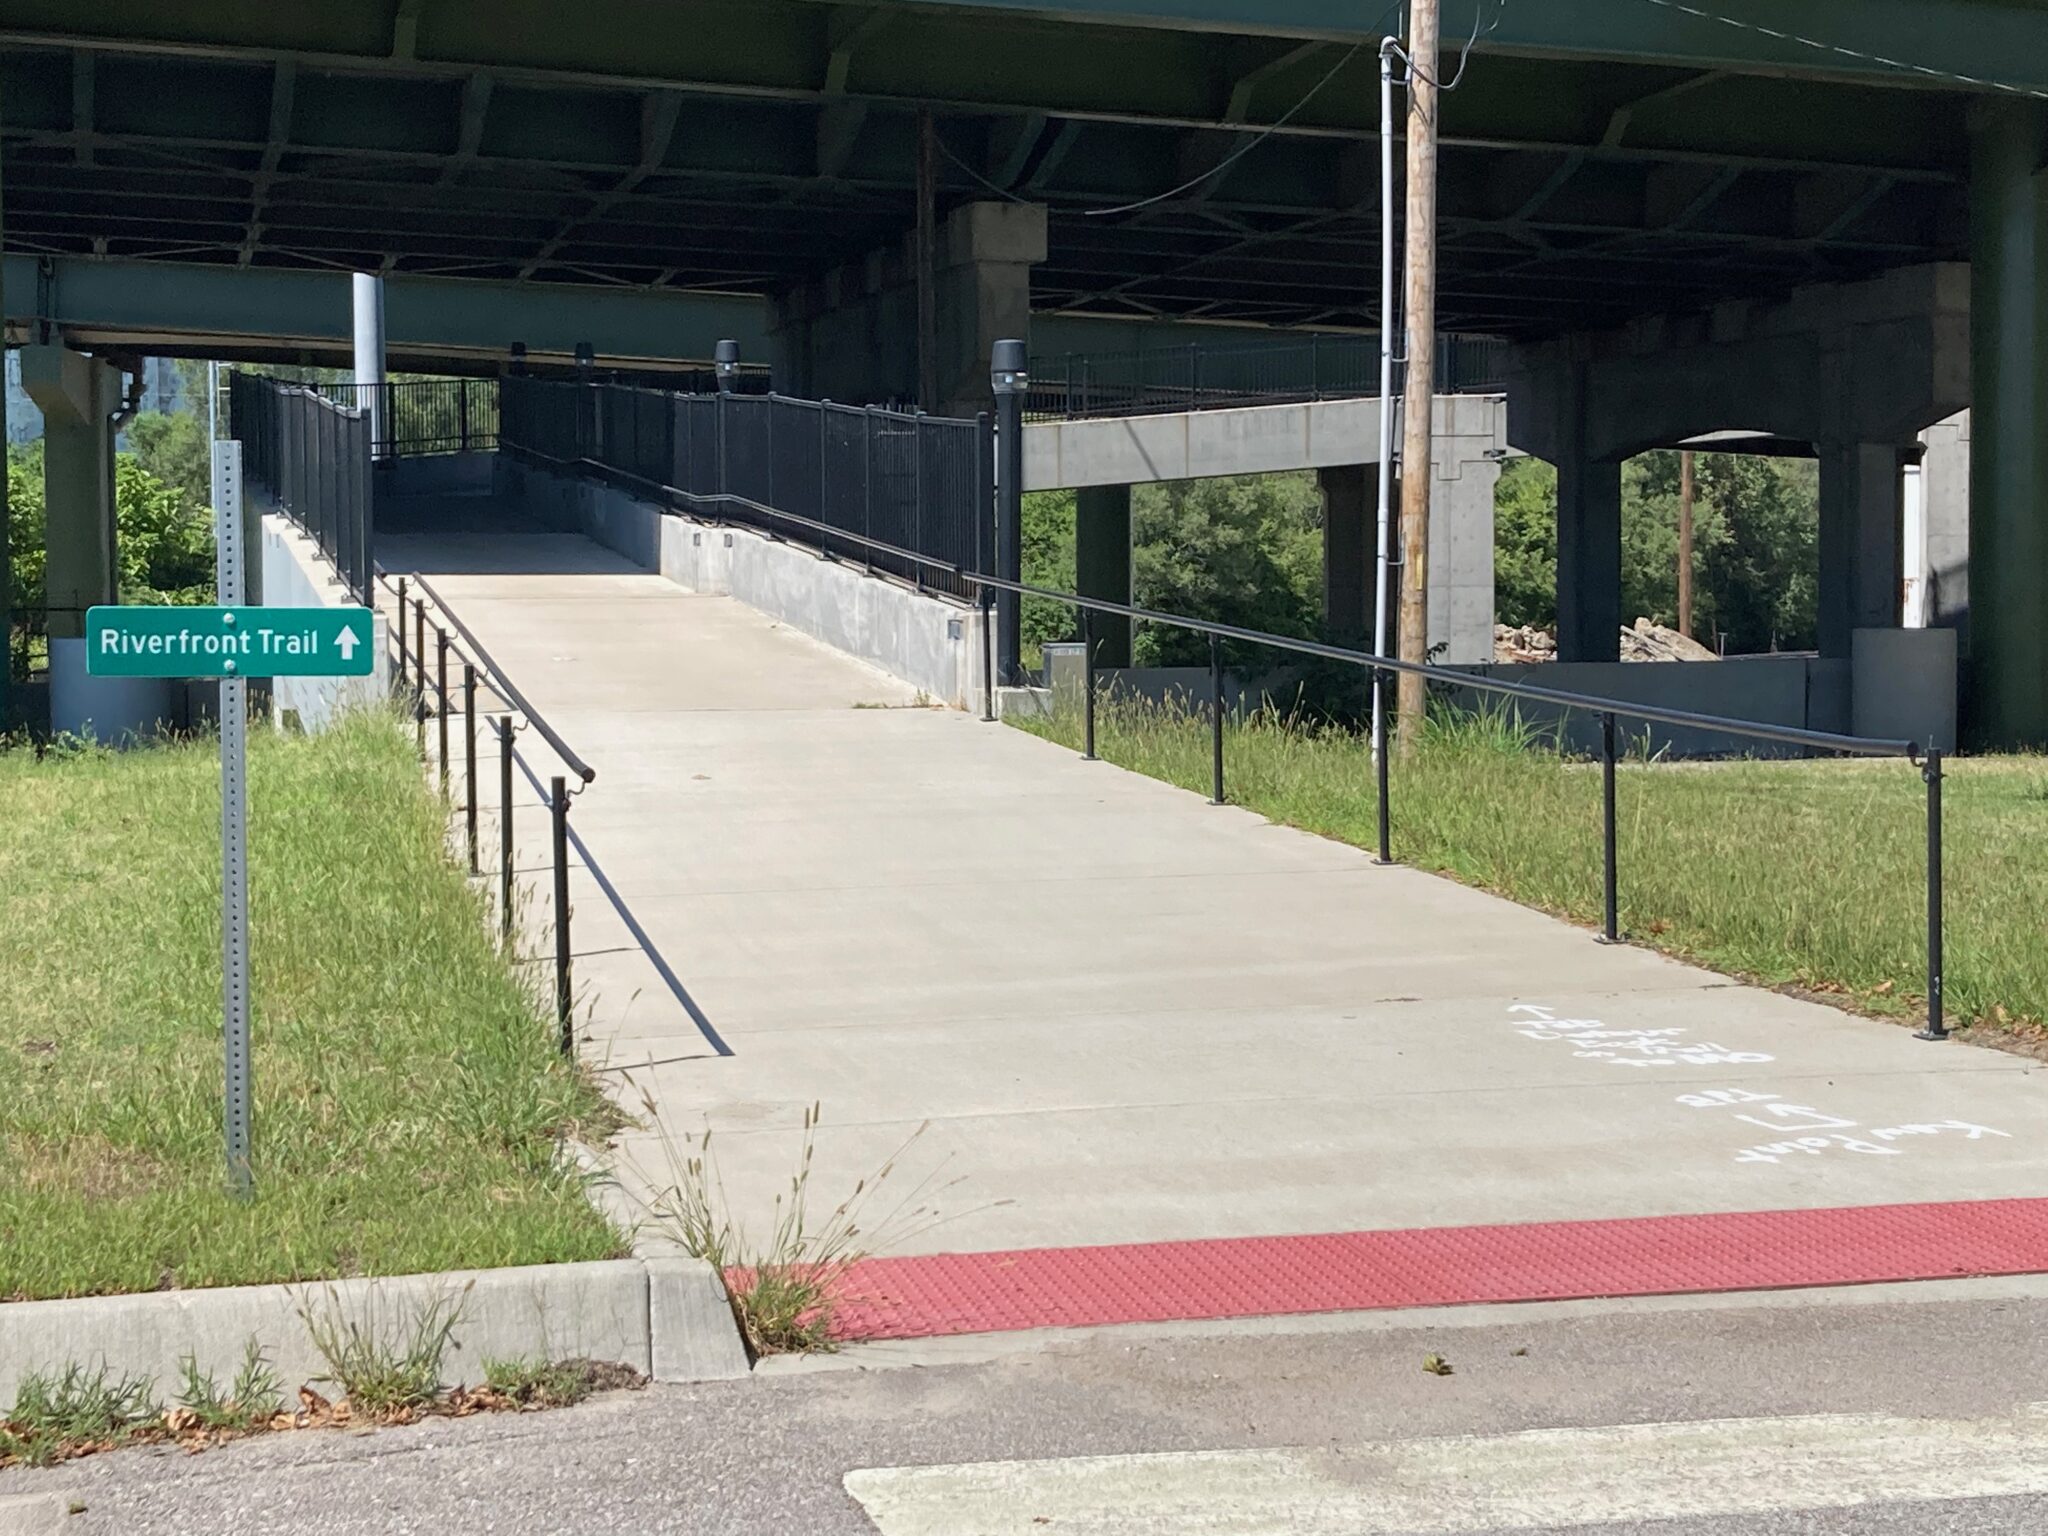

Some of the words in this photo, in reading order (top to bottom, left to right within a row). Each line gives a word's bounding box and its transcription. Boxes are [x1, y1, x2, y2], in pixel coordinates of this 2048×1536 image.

[100, 628, 251, 655] Riverfront
[257, 628, 318, 655] Trail
[1869, 1119, 2012, 1140] Kaw
[1734, 1134, 1902, 1163] Point
